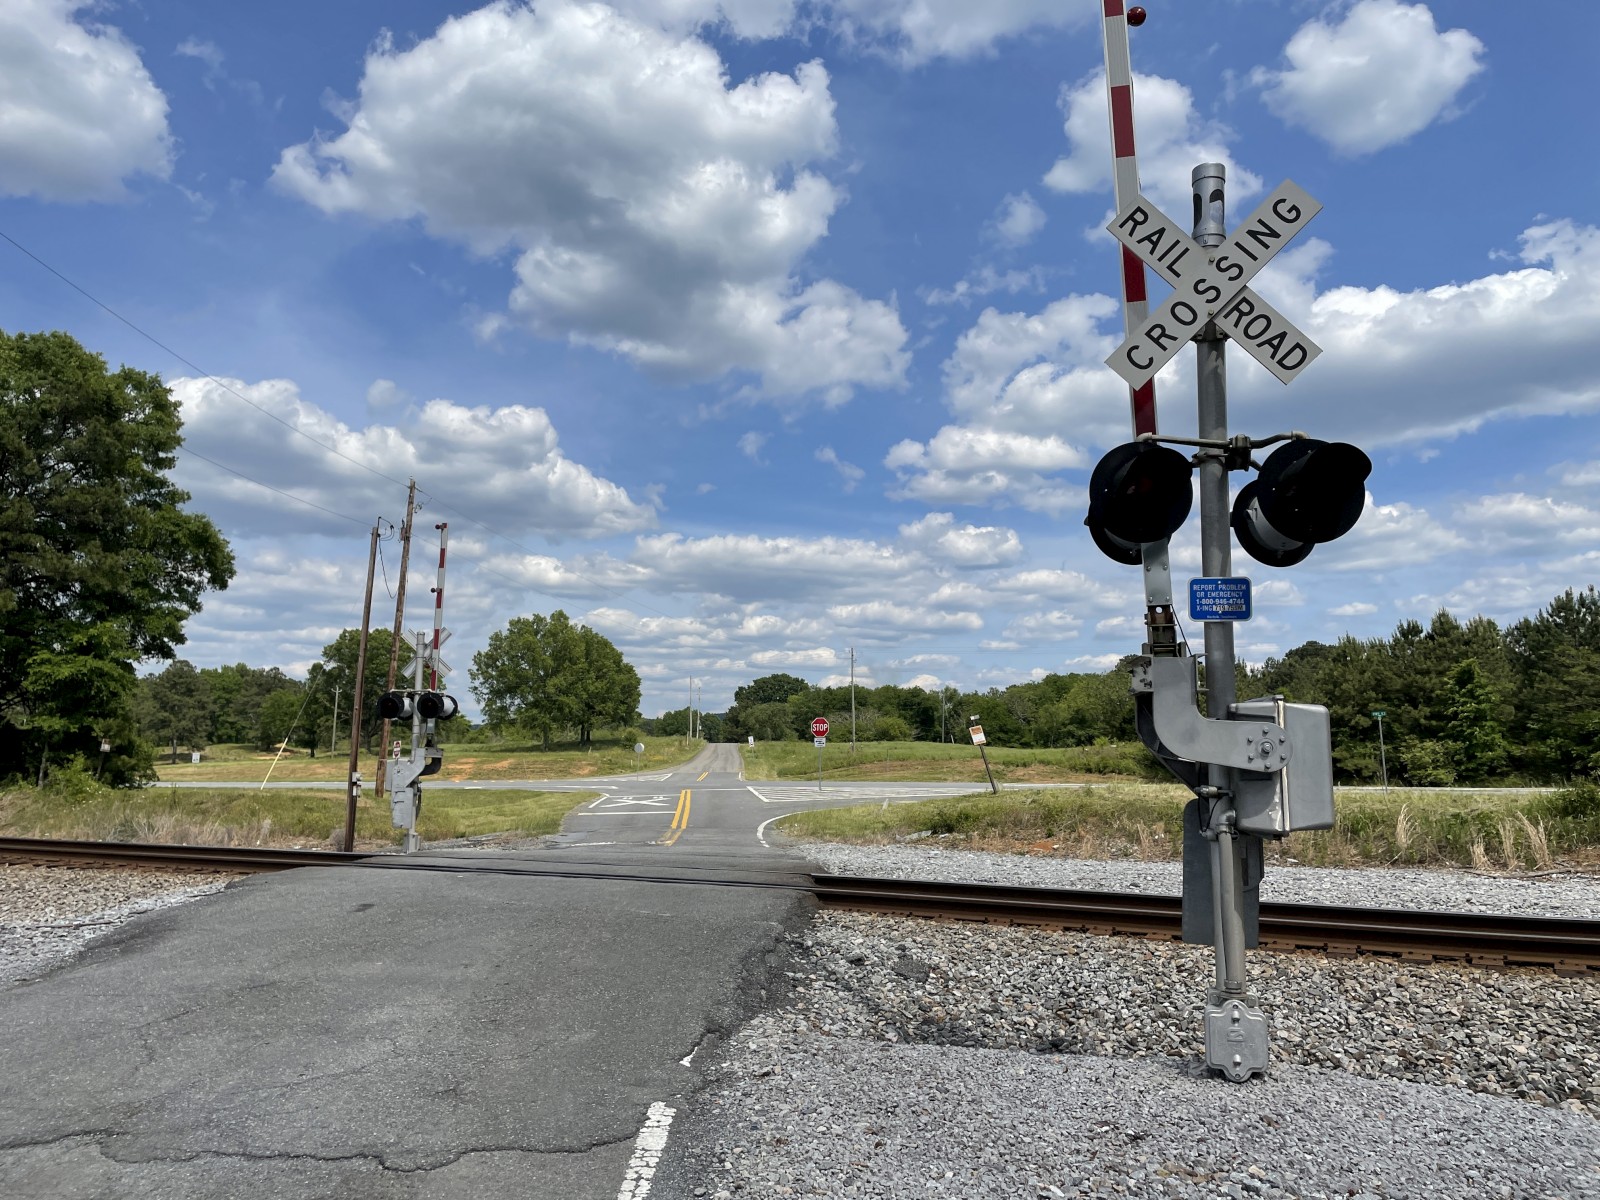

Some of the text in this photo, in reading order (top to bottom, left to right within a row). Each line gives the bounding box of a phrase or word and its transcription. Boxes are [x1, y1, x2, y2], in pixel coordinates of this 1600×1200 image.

[1118, 205, 1308, 371] RAIL ROAD
[1126, 198, 1302, 370] CROSSING
[812, 723, 828, 731] STOP
